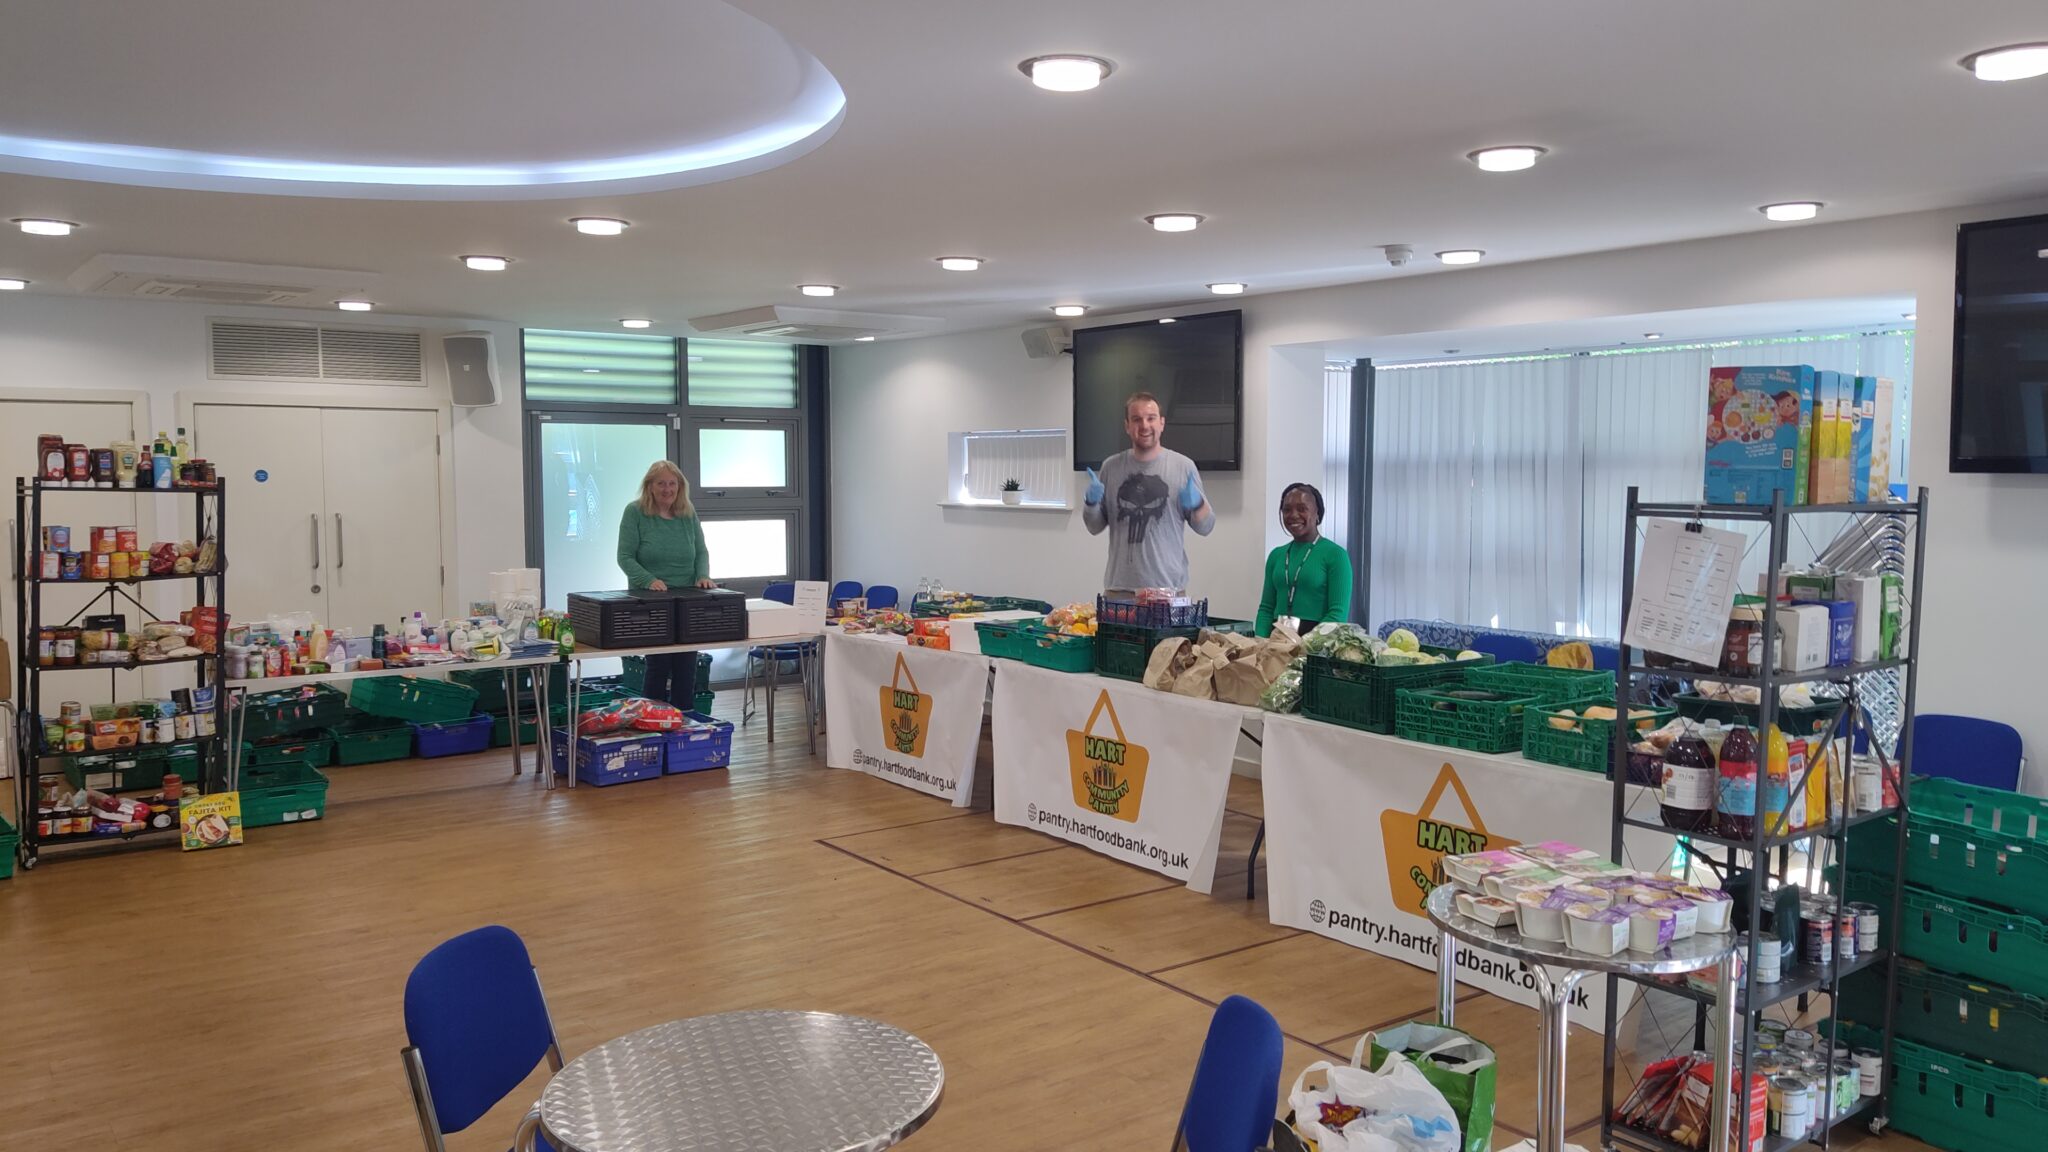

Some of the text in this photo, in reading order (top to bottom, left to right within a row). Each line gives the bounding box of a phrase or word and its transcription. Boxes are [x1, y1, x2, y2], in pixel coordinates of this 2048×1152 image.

[893, 689, 919, 712] HART
[1085, 735, 1126, 765] HART
[863, 754, 957, 792] pantry.hartfoodbank.org.uk
[1083, 771, 1130, 801] COMMUNITY
[188, 806, 217, 815] FAJITA
[1088, 795, 1119, 815] PANTRY
[1038, 810, 1189, 869] pantry.hartfoodbank.org.uk
[1417, 819, 1488, 855] HART
